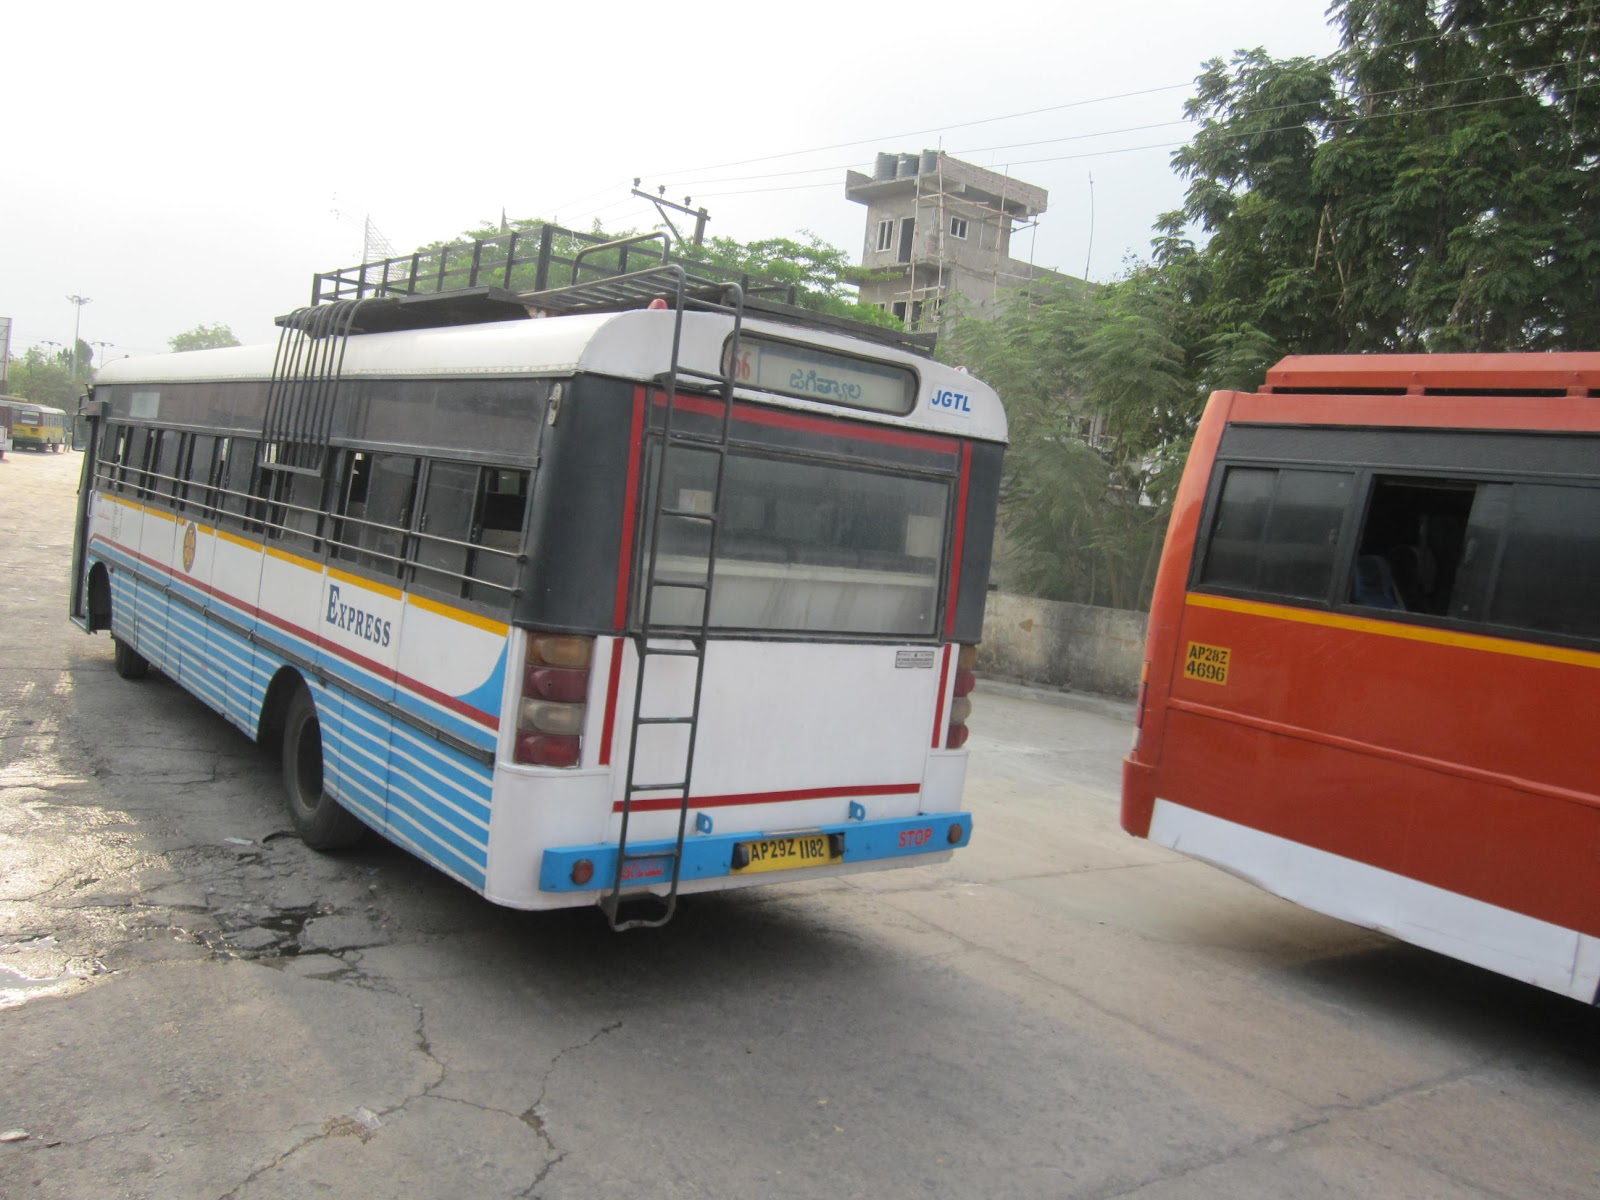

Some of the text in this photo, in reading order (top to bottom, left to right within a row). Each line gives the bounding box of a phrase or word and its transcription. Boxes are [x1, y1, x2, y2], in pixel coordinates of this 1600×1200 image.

[931, 389, 971, 412] JGTL
[1188, 645, 1228, 665] AP28Z
[1186, 660, 1226, 682] 4696
[898, 827, 933, 848] STOP
[751, 838, 824, 861] AP29Z 1182
